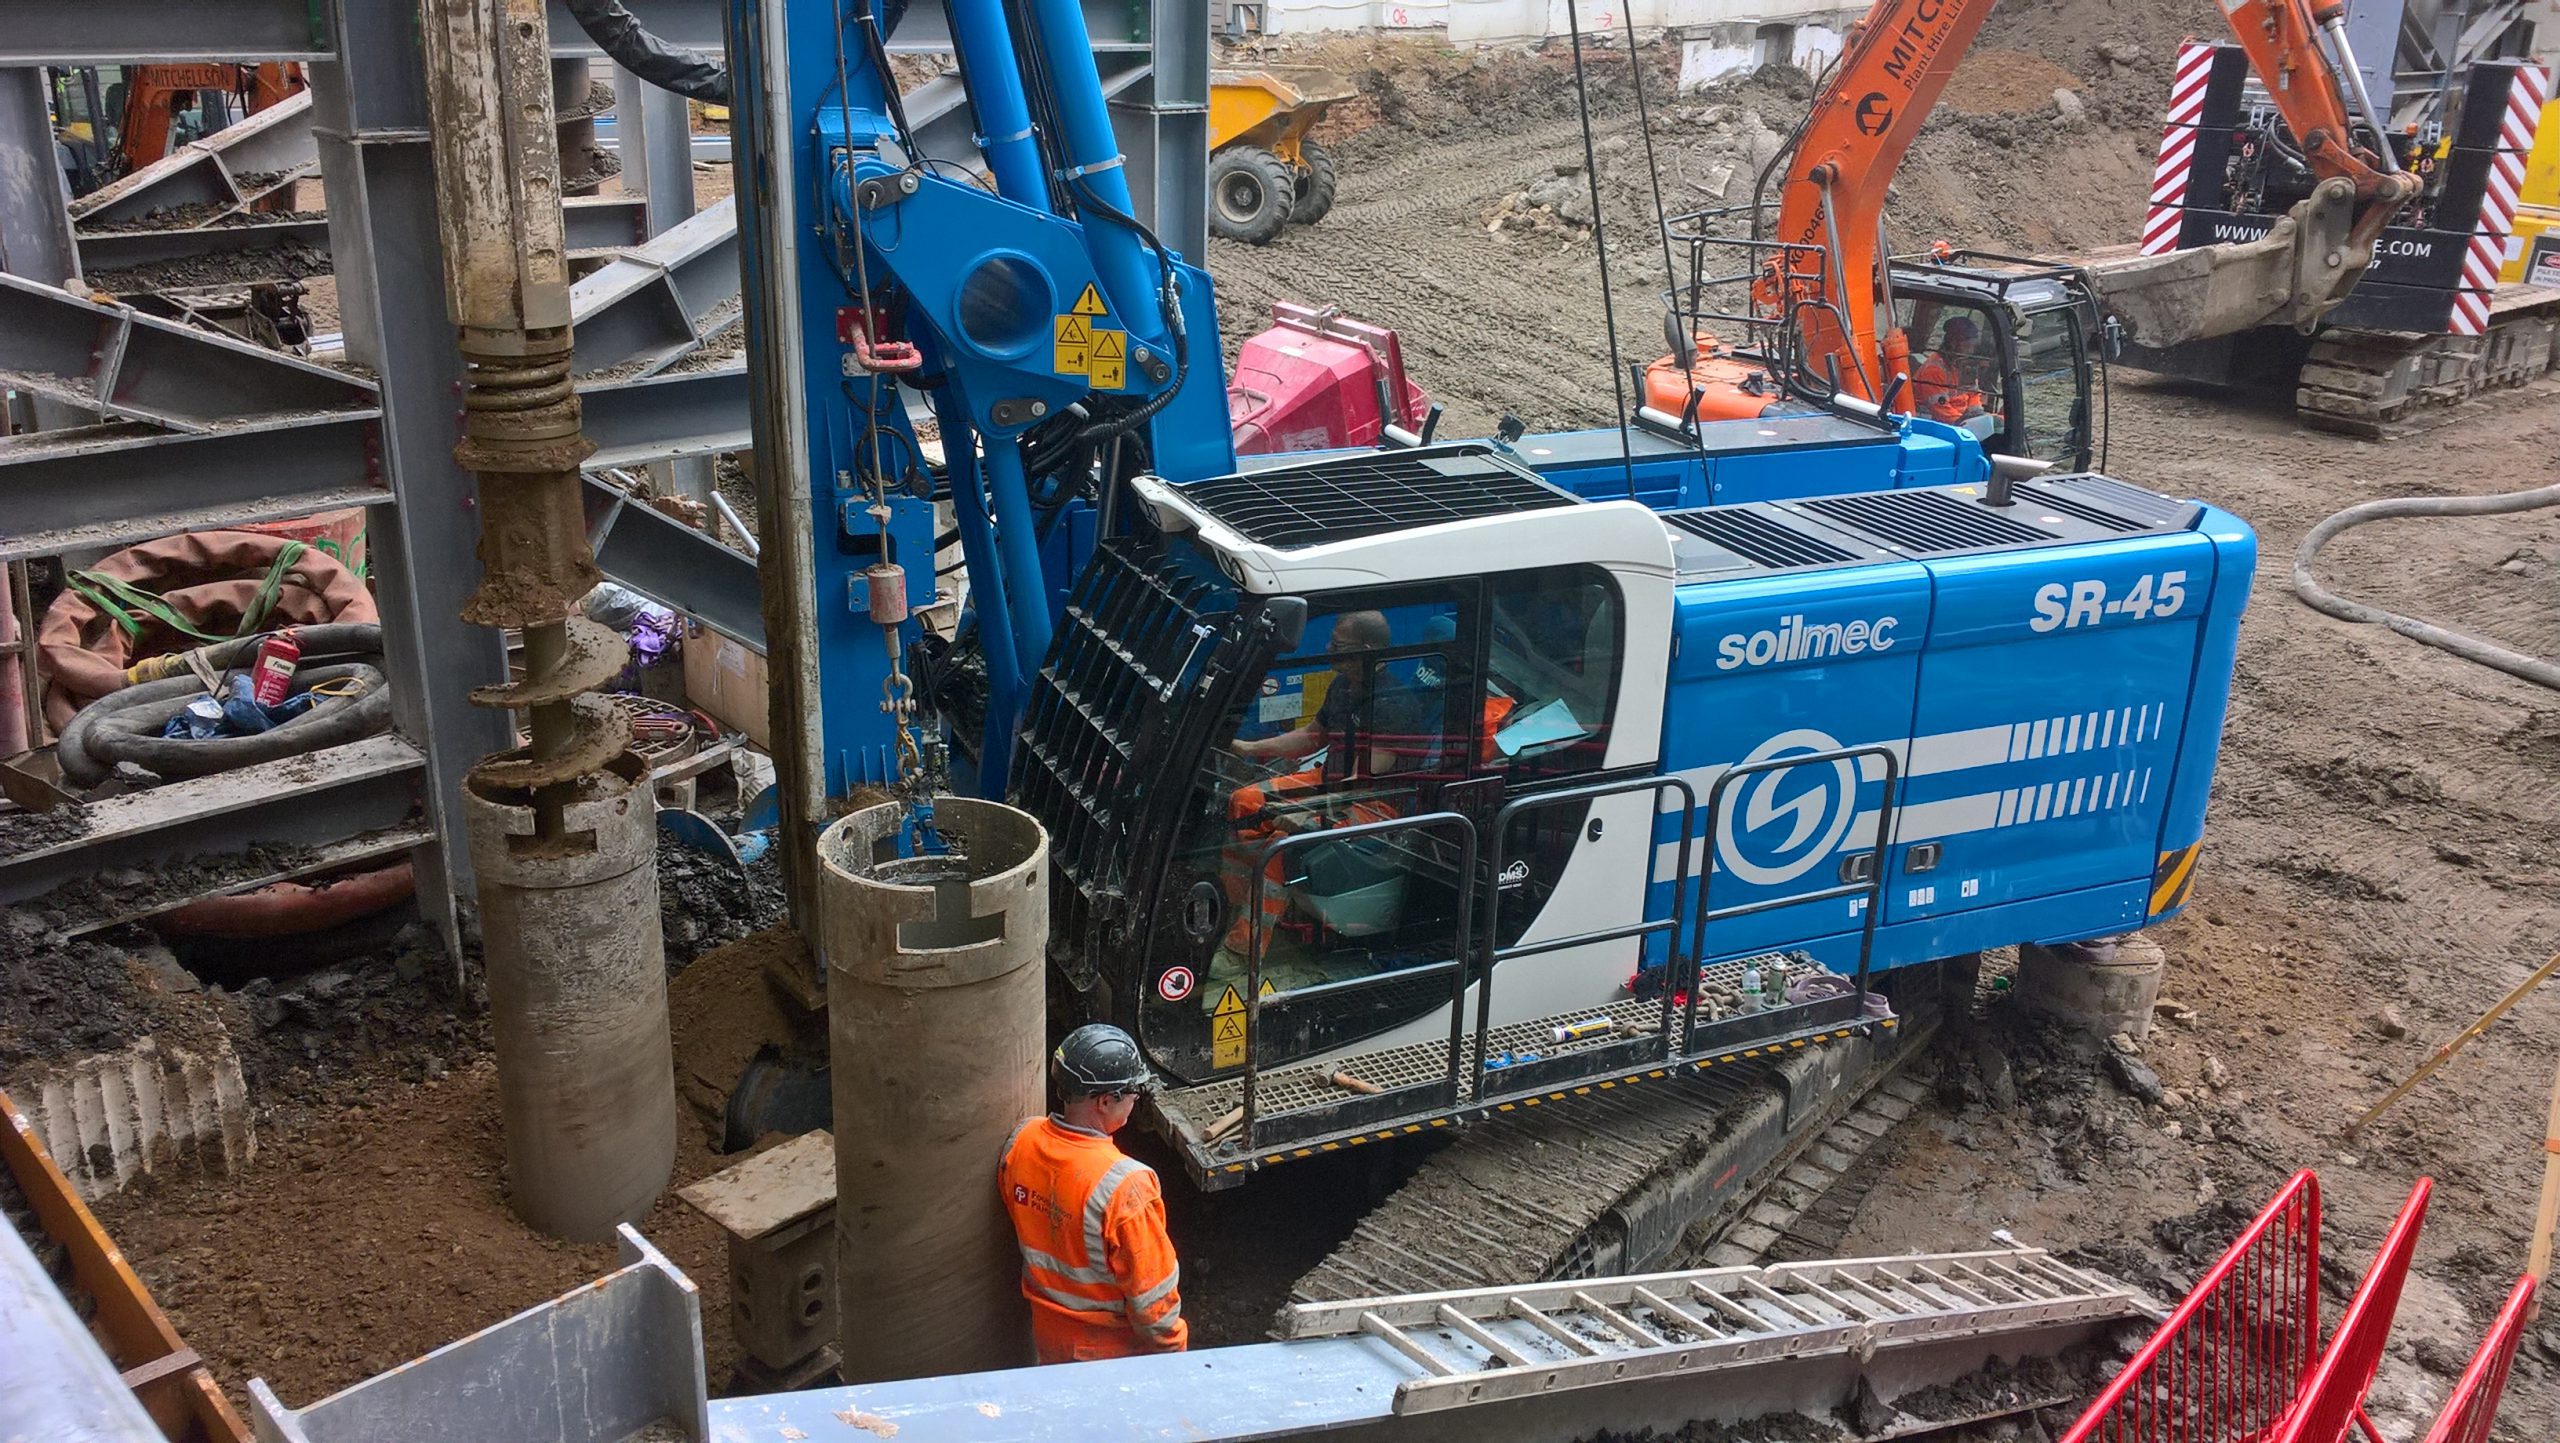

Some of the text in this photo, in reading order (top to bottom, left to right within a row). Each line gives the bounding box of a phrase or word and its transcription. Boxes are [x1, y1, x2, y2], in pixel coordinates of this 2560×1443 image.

[1392, 8, 1408, 25] 06
[1883, 0, 1943, 80] MITC
[149, 67, 231, 88] MITCHELLSON
[1903, 53, 1931, 91] Plant
[1926, 20, 1951, 53] Hire
[2029, 570, 2187, 633] SR-45
[1715, 614, 1899, 671] soilmec
[1498, 870, 1523, 883] DMS
